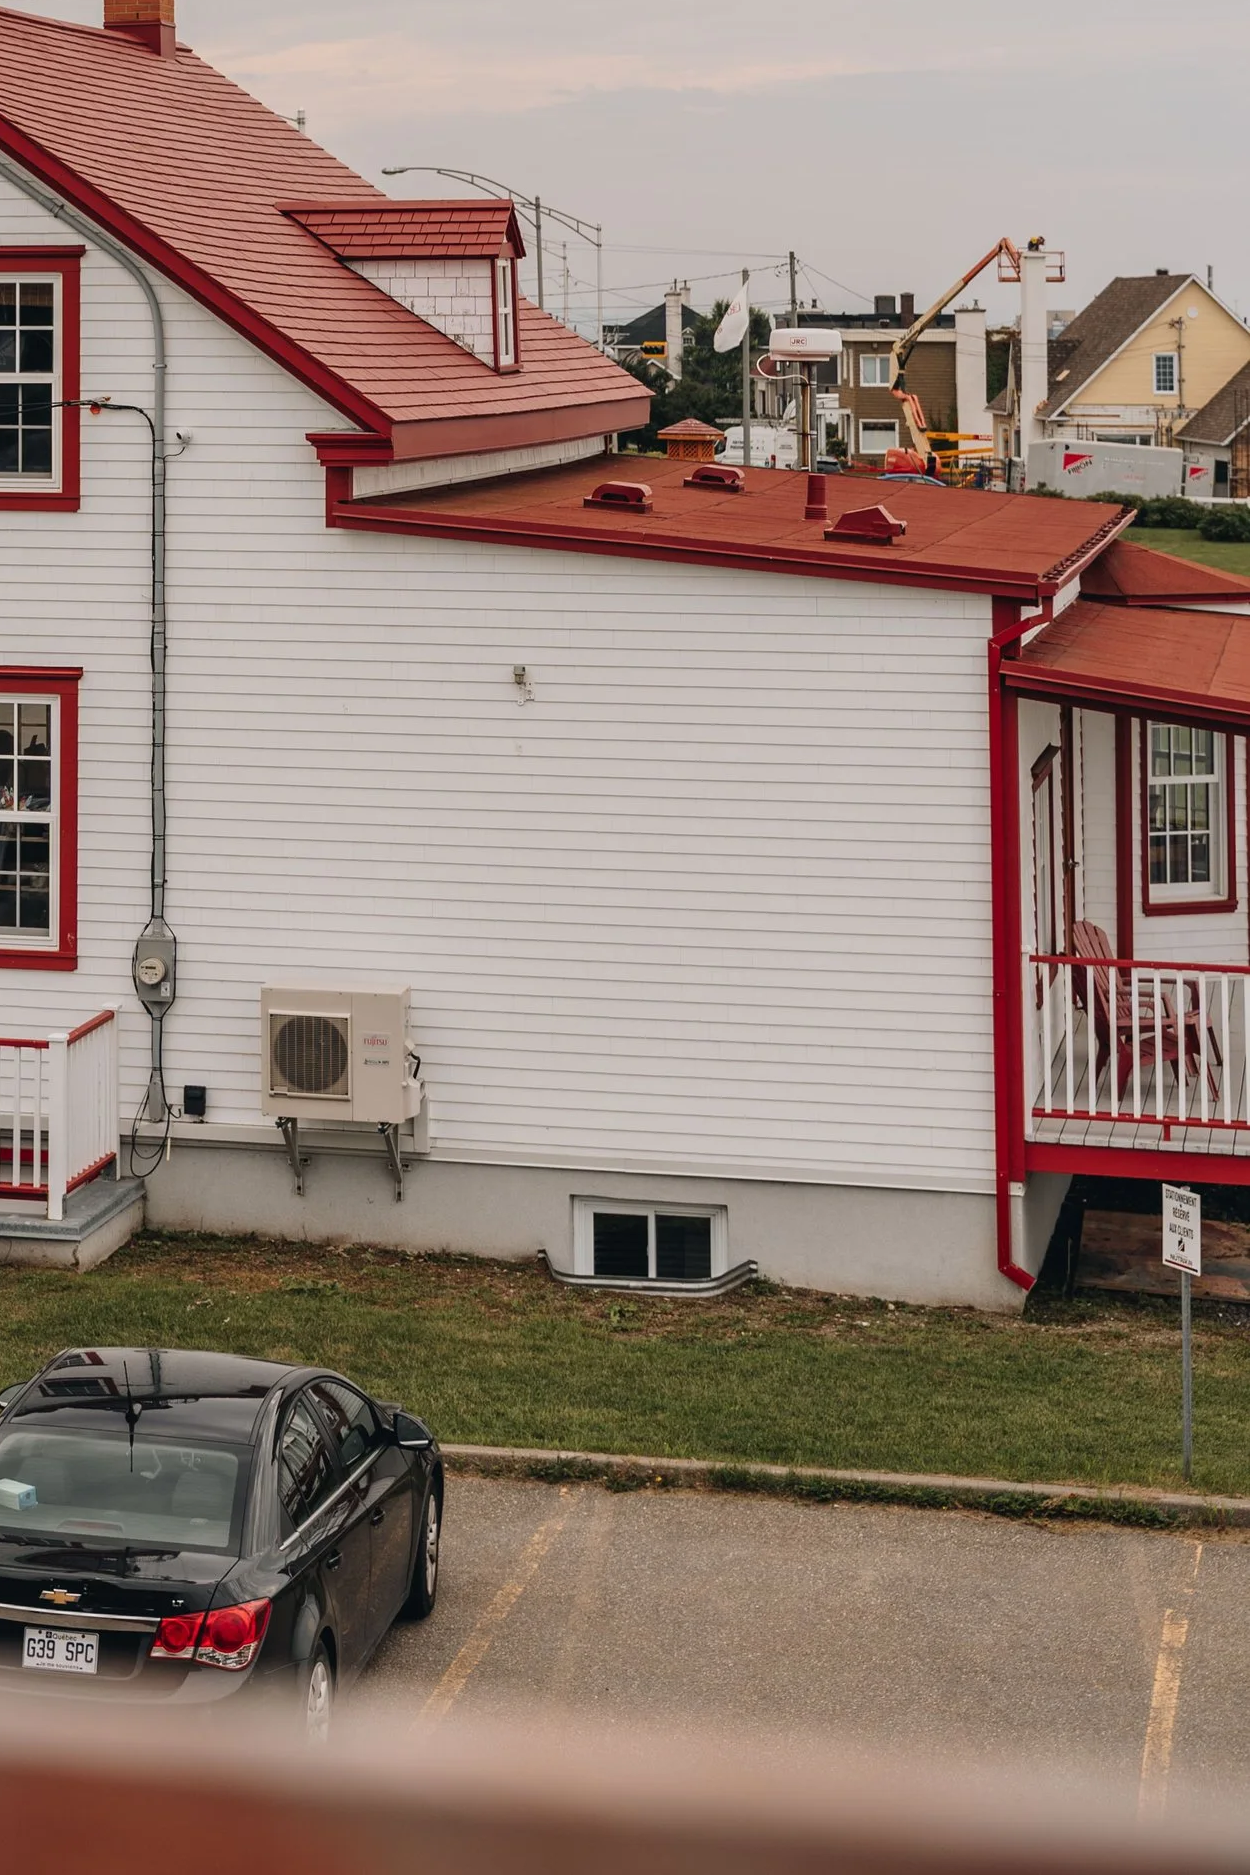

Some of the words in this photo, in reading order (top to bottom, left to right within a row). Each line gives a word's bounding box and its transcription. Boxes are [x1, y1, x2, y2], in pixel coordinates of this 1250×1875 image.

[791, 338, 806, 346] JRC
[1165, 1188, 1197, 1207] STATIONNEMENT
[1169, 1222, 1177, 1233] AUX
[1177, 1224, 1194, 1240] CLIENTS
[172, 1599, 184, 1608] LT
[53, 1633, 77, 1642] Québec
[27, 1638, 56, 1660] G39
[65, 1641, 94, 1664] SPC
